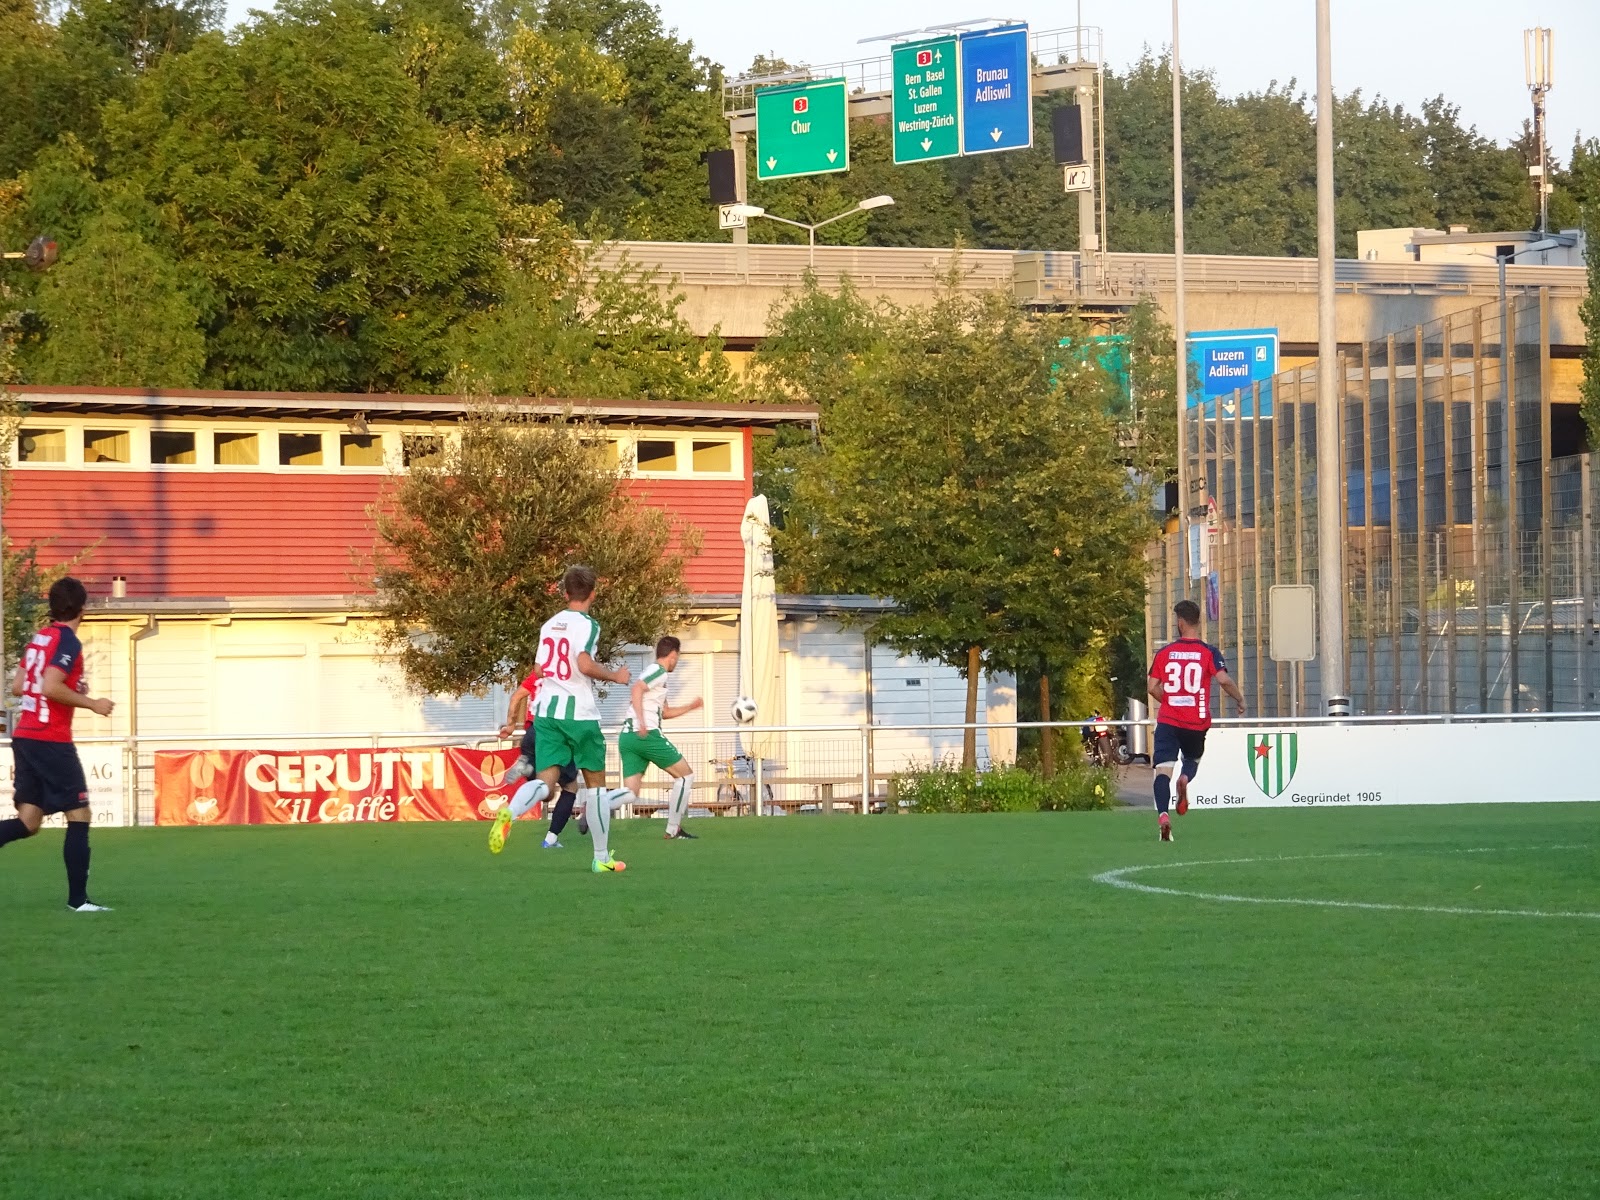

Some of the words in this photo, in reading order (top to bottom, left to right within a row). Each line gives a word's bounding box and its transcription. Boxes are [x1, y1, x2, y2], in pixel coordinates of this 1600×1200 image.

[905, 74, 922, 86] Bern
[926, 68, 945, 82] Basel
[976, 68, 1008, 83] Brunau
[908, 88, 918, 100] St.
[920, 85, 942, 98] Gallen
[975, 83, 1011, 102] Adliswil
[914, 103, 937, 114] Luzern
[791, 120, 811, 135] Chur
[899, 114, 954, 132] Westring-Zürich
[1212, 350, 1244, 361] Luzern
[1256, 348, 1265, 360] 4
[1208, 364, 1248, 377] Adliswil
[542, 637, 572, 680] 28
[1164, 662, 1202, 694] 30
[90, 763, 113, 780] AG
[244, 752, 446, 793] CERUTTI
[1196, 795, 1218, 805] Red
[1223, 794, 1246, 804] Star
[1291, 792, 1351, 807] Gegründet
[1357, 792, 1382, 802] 1905
